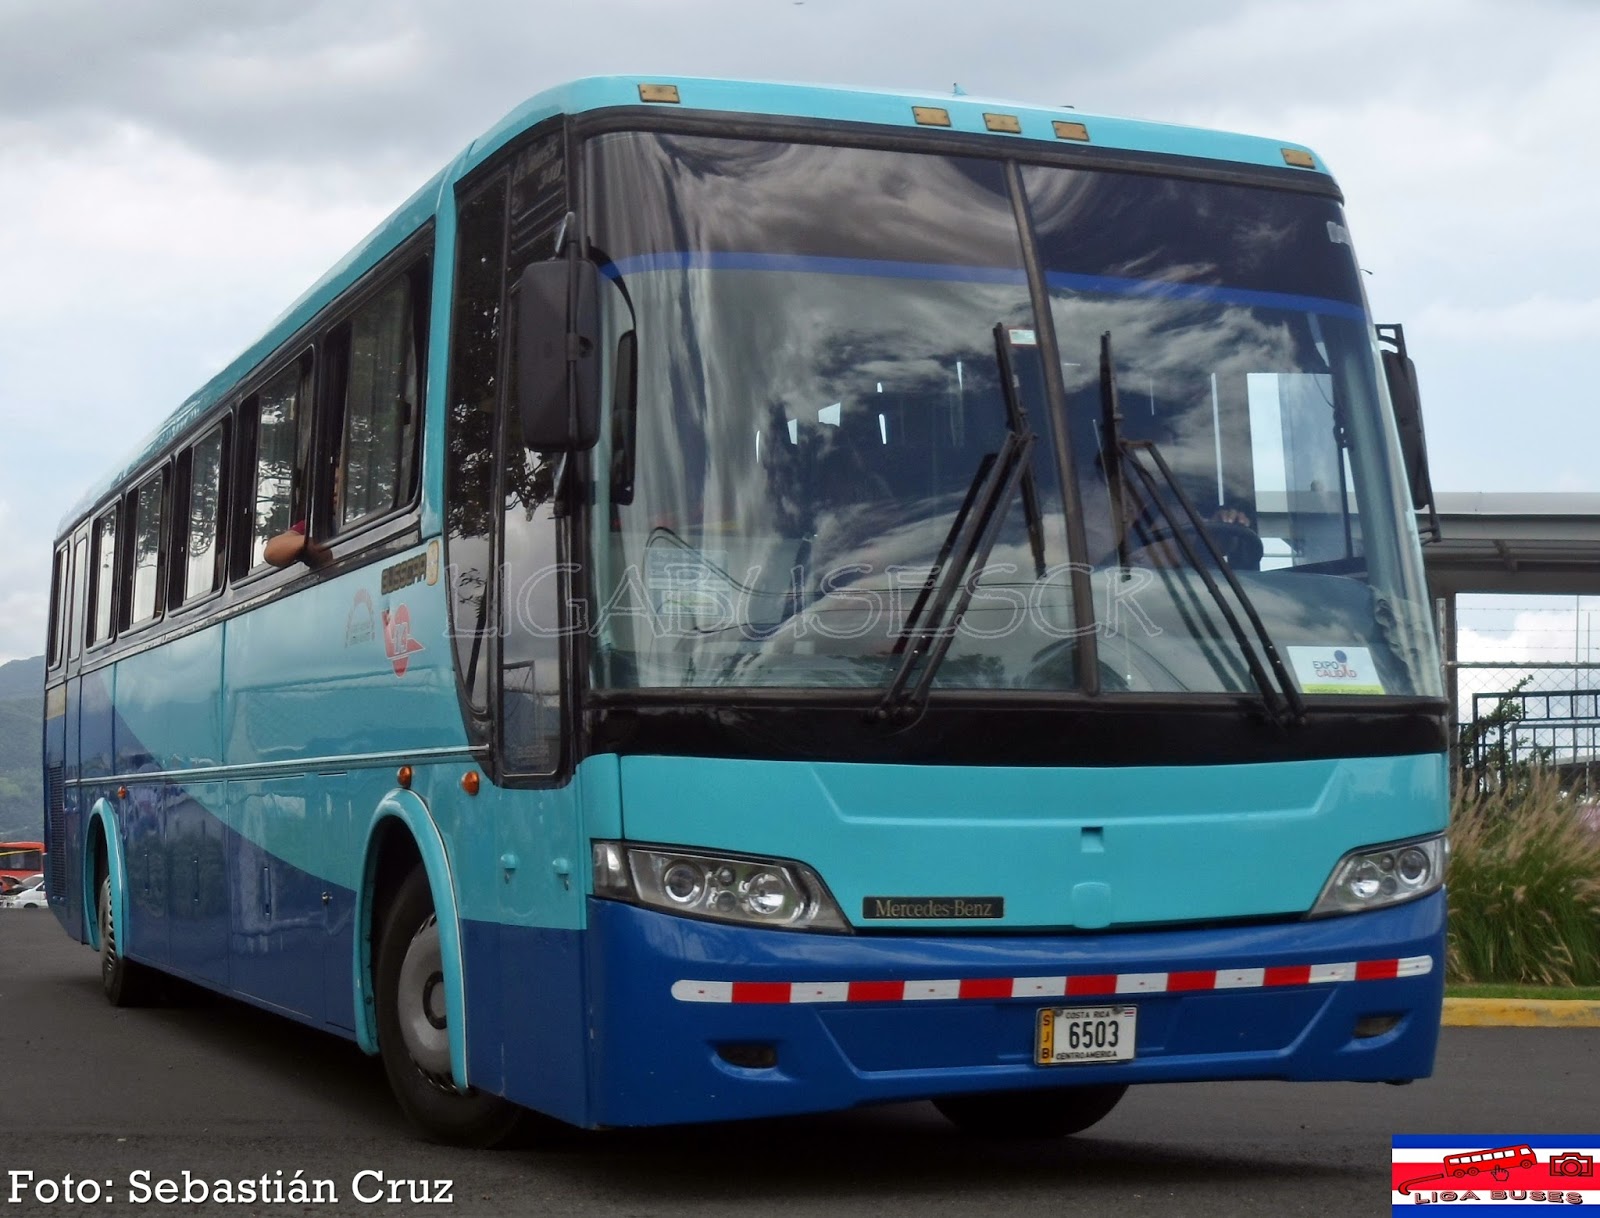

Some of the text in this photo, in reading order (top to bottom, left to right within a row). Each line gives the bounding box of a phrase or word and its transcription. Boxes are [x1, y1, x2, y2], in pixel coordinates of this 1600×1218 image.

[1312, 661, 1338, 669] EXPO
[875, 899, 994, 918] Mercedes-Benz
[1069, 1020, 1119, 1049] 6503
